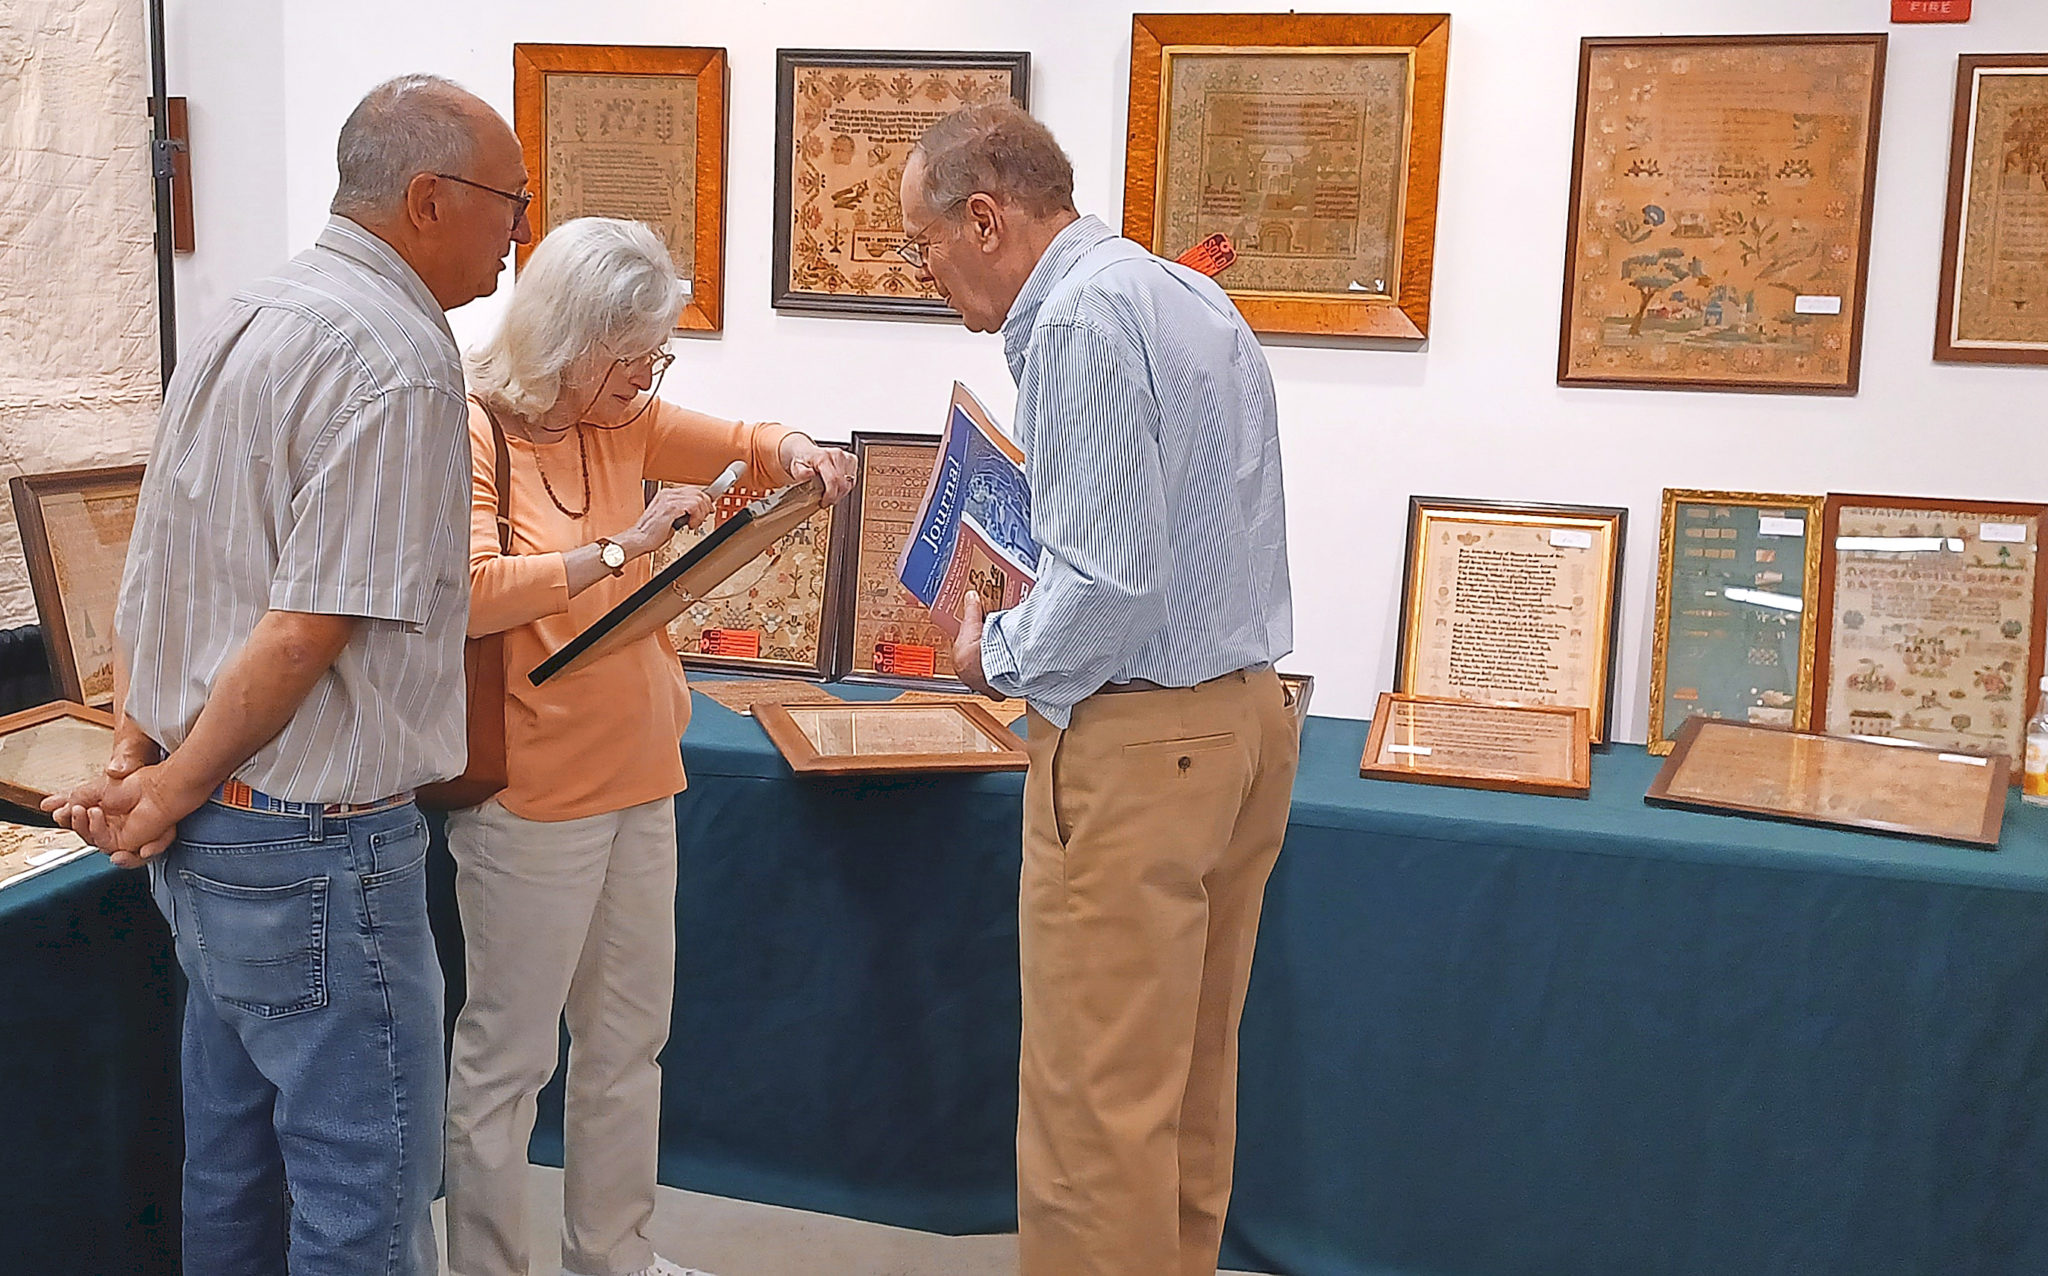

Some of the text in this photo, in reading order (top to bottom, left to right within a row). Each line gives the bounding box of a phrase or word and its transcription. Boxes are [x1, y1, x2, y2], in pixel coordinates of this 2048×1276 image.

[1910, 1, 1951, 13] FIRE
[1204, 239, 1227, 267] SOLD
[920, 456, 961, 555] Journal
[883, 644, 894, 673] SOLD
